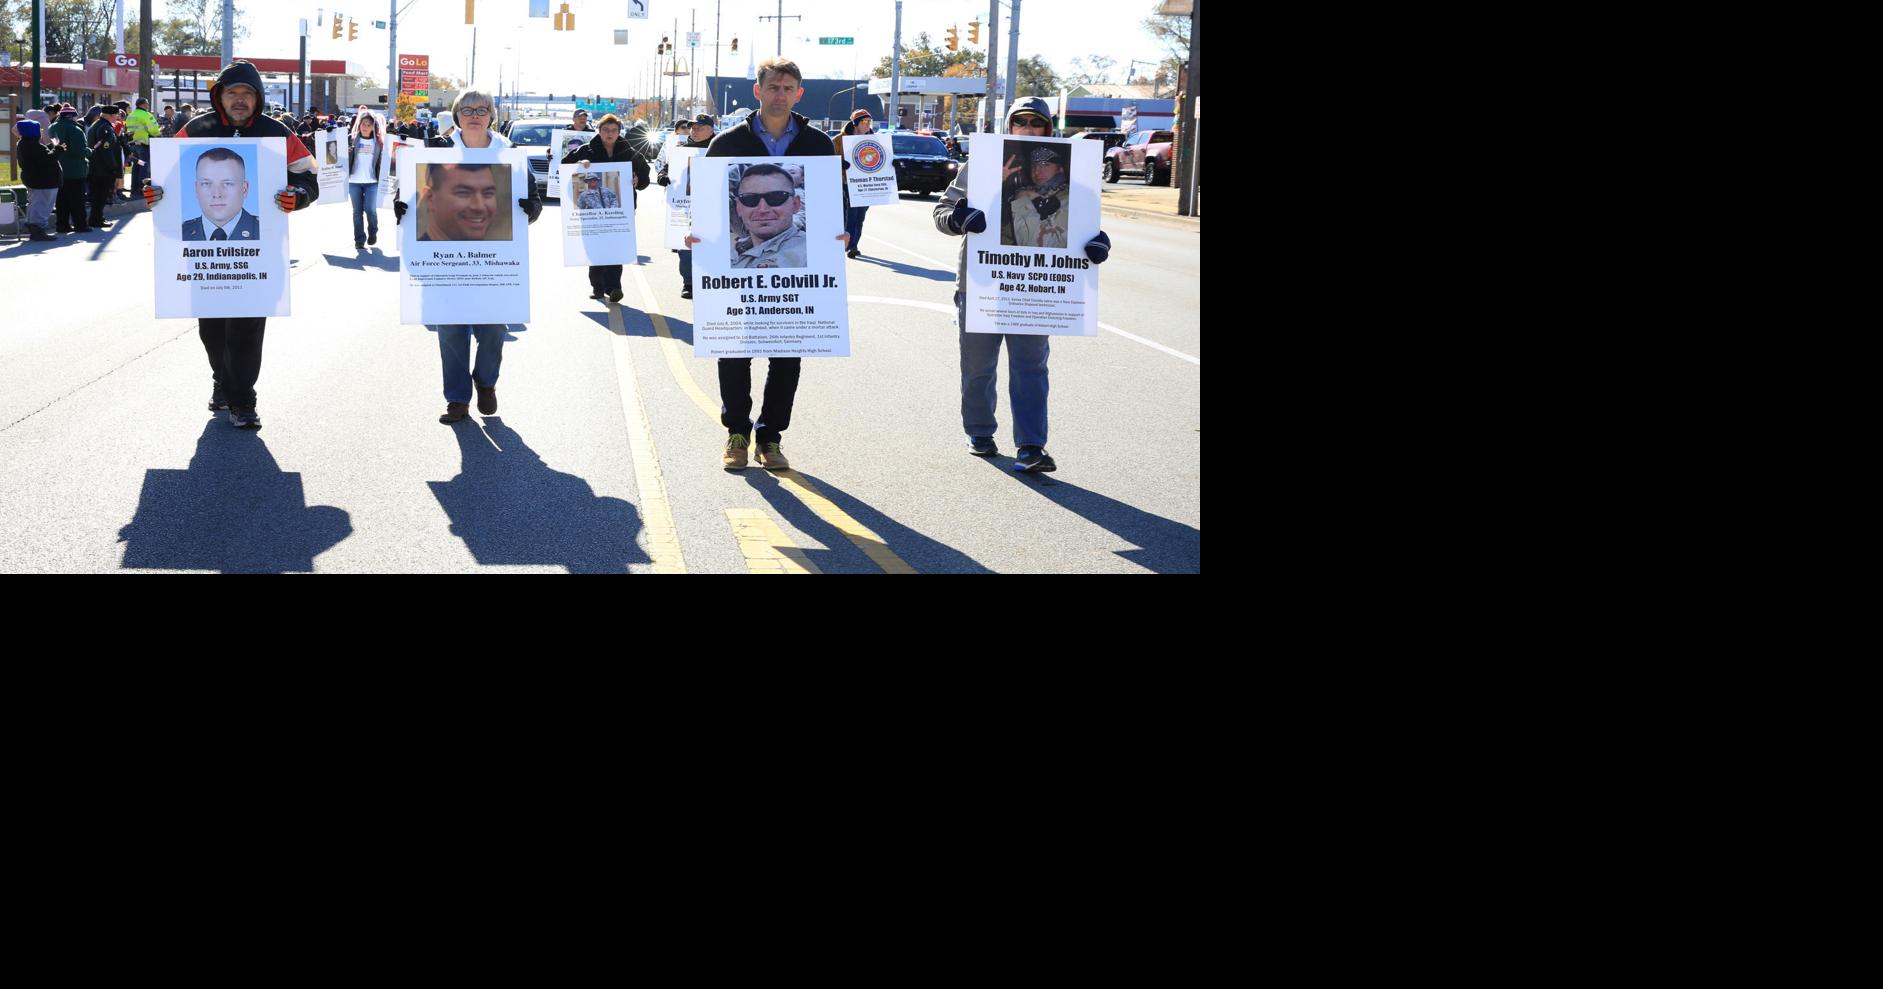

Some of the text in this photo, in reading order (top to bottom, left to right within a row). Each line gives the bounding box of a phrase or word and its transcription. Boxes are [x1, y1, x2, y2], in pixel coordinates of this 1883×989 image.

[115, 55, 137, 66] Go
[182, 247, 260, 257] Aaron Evilsizer
[978, 251, 1089, 269] Timothy M. Johns
[210, 262, 232, 270] Army,
[207, 272, 257, 281] Indianapolis,
[992, 270, 1005, 279] U.S.
[1007, 272, 1025, 280] Navy
[1028, 273, 1048, 281] SCPO
[702, 275, 838, 289] Robert E. Colvill Jr.
[1000, 283, 1014, 292] Age
[1016, 284, 1027, 293] 42,
[1029, 284, 1056, 294] Hobart,
[758, 294, 780, 304] Army
[782, 294, 799, 302] SGT
[727, 306, 814, 316] Age 31, Anderson, IN
